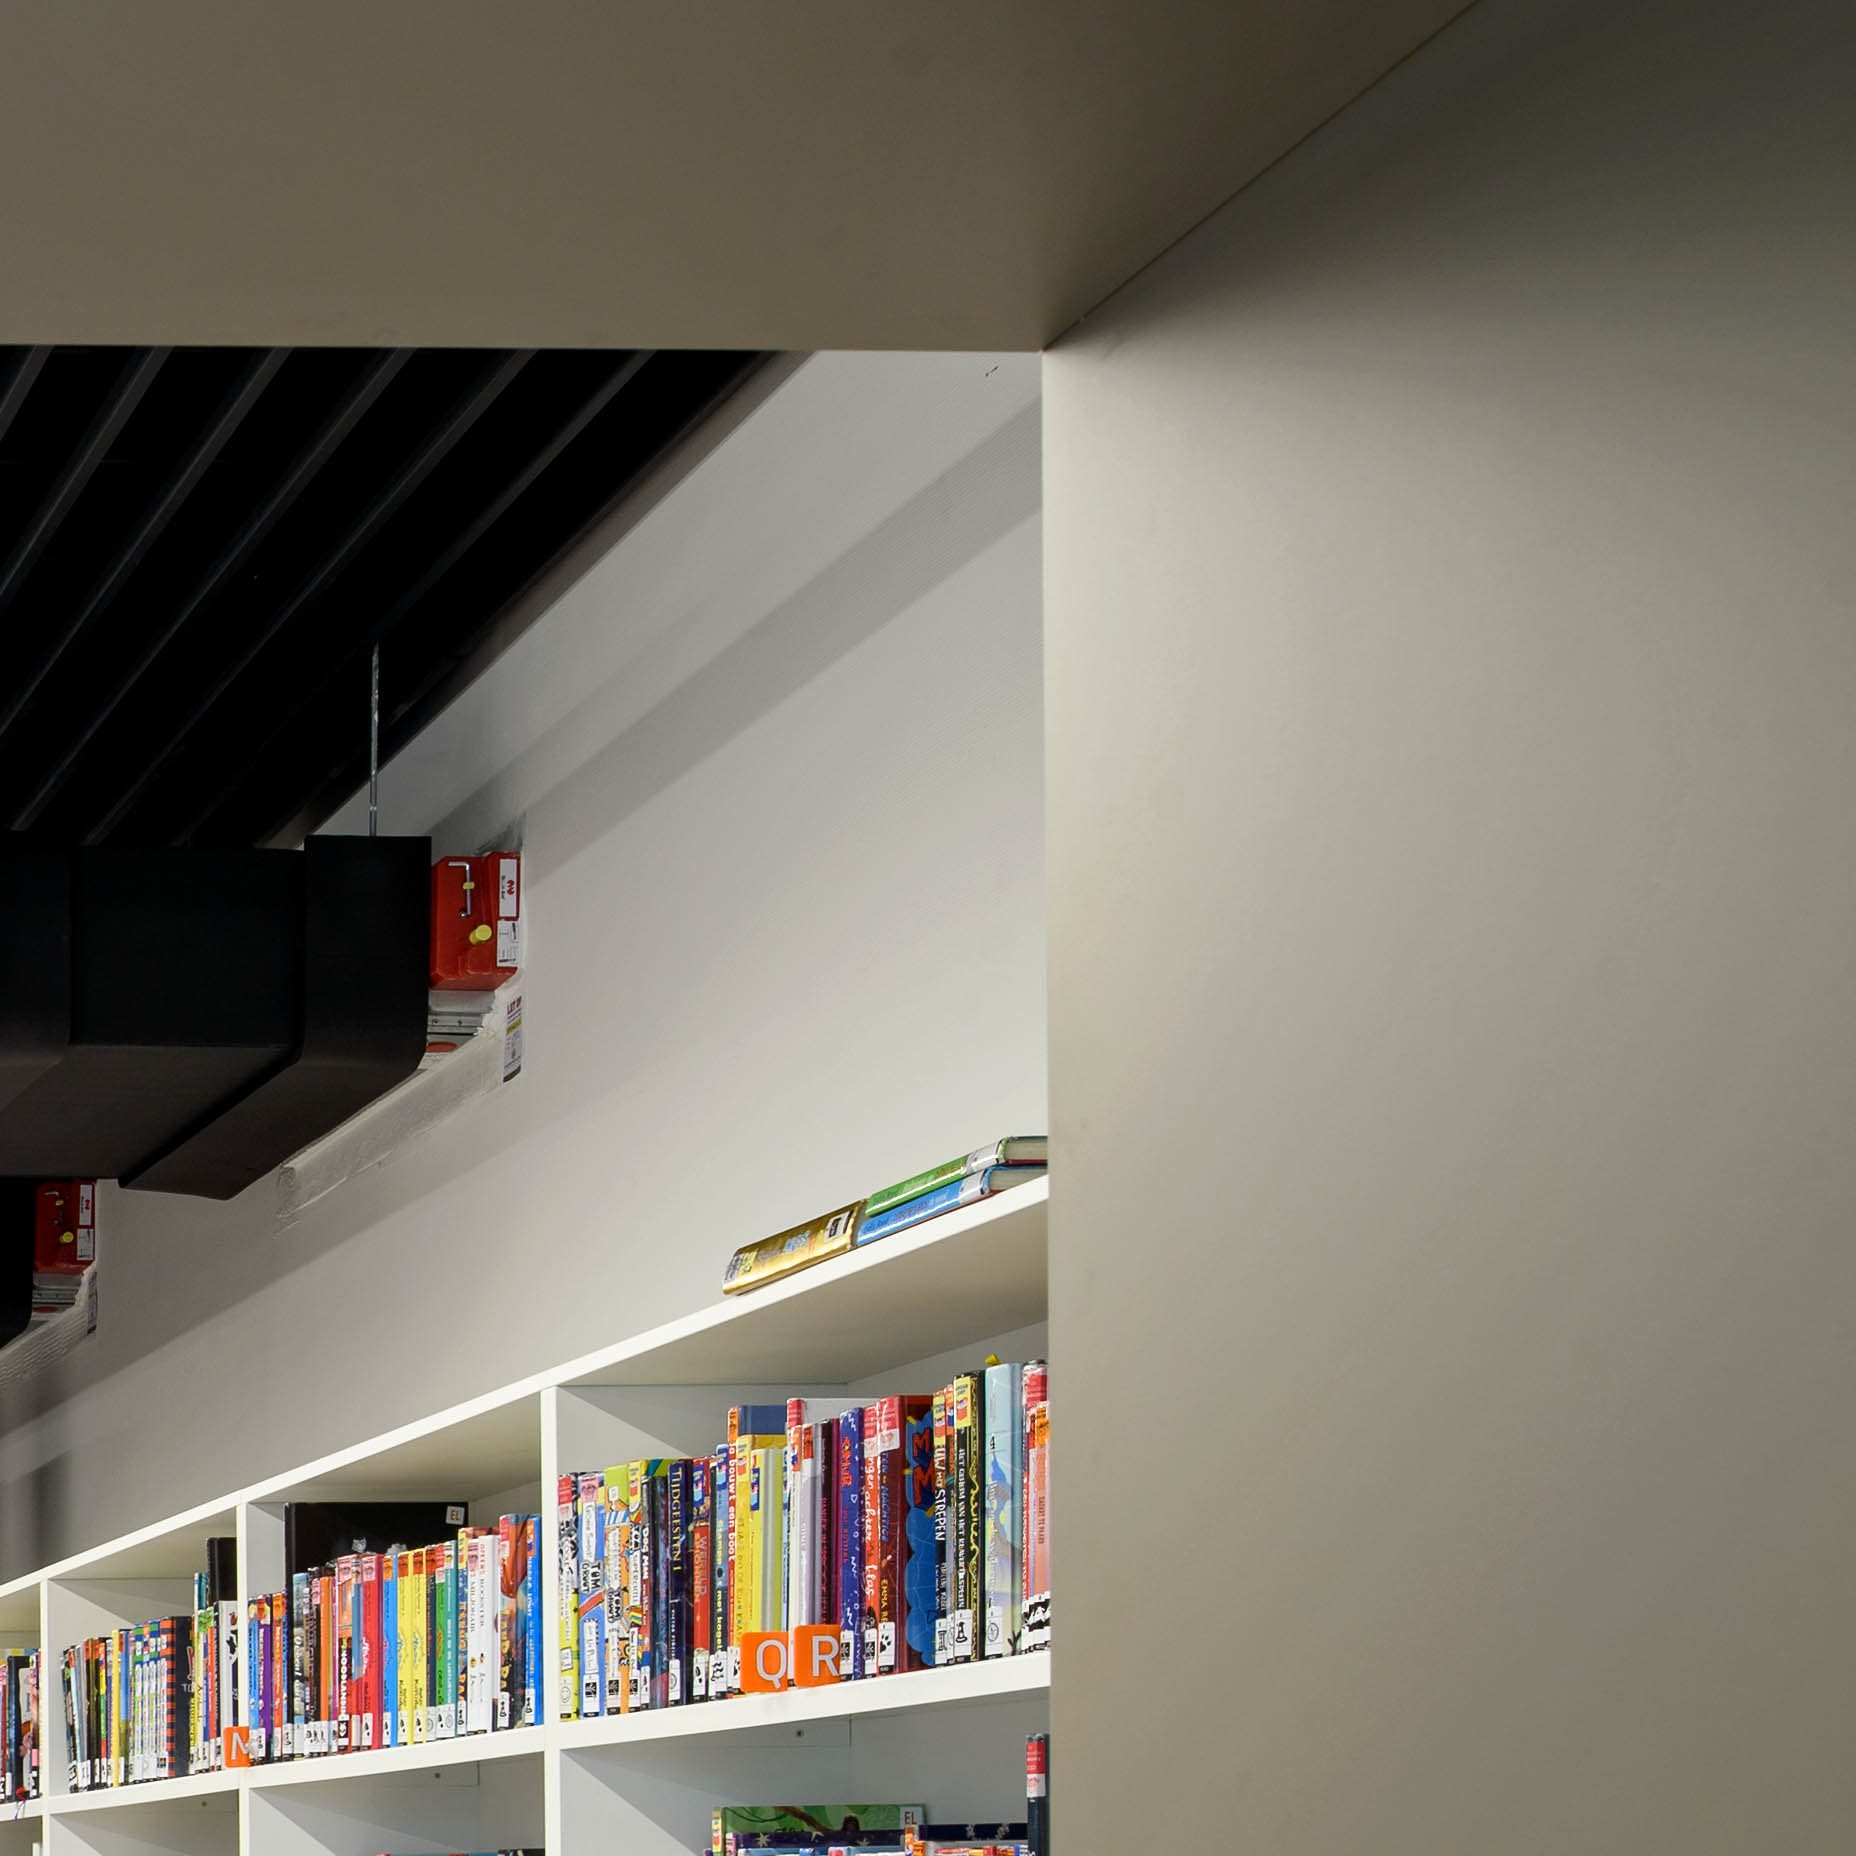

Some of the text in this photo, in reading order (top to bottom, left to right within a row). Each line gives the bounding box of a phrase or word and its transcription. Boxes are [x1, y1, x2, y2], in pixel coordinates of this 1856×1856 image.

[728, 1460, 737, 1501] bouwt
[934, 1489, 946, 1541] STREPEN
[728, 1532, 737, 1561] boot
[755, 1640, 788, 1690] Q
[811, 1634, 839, 1677] R
